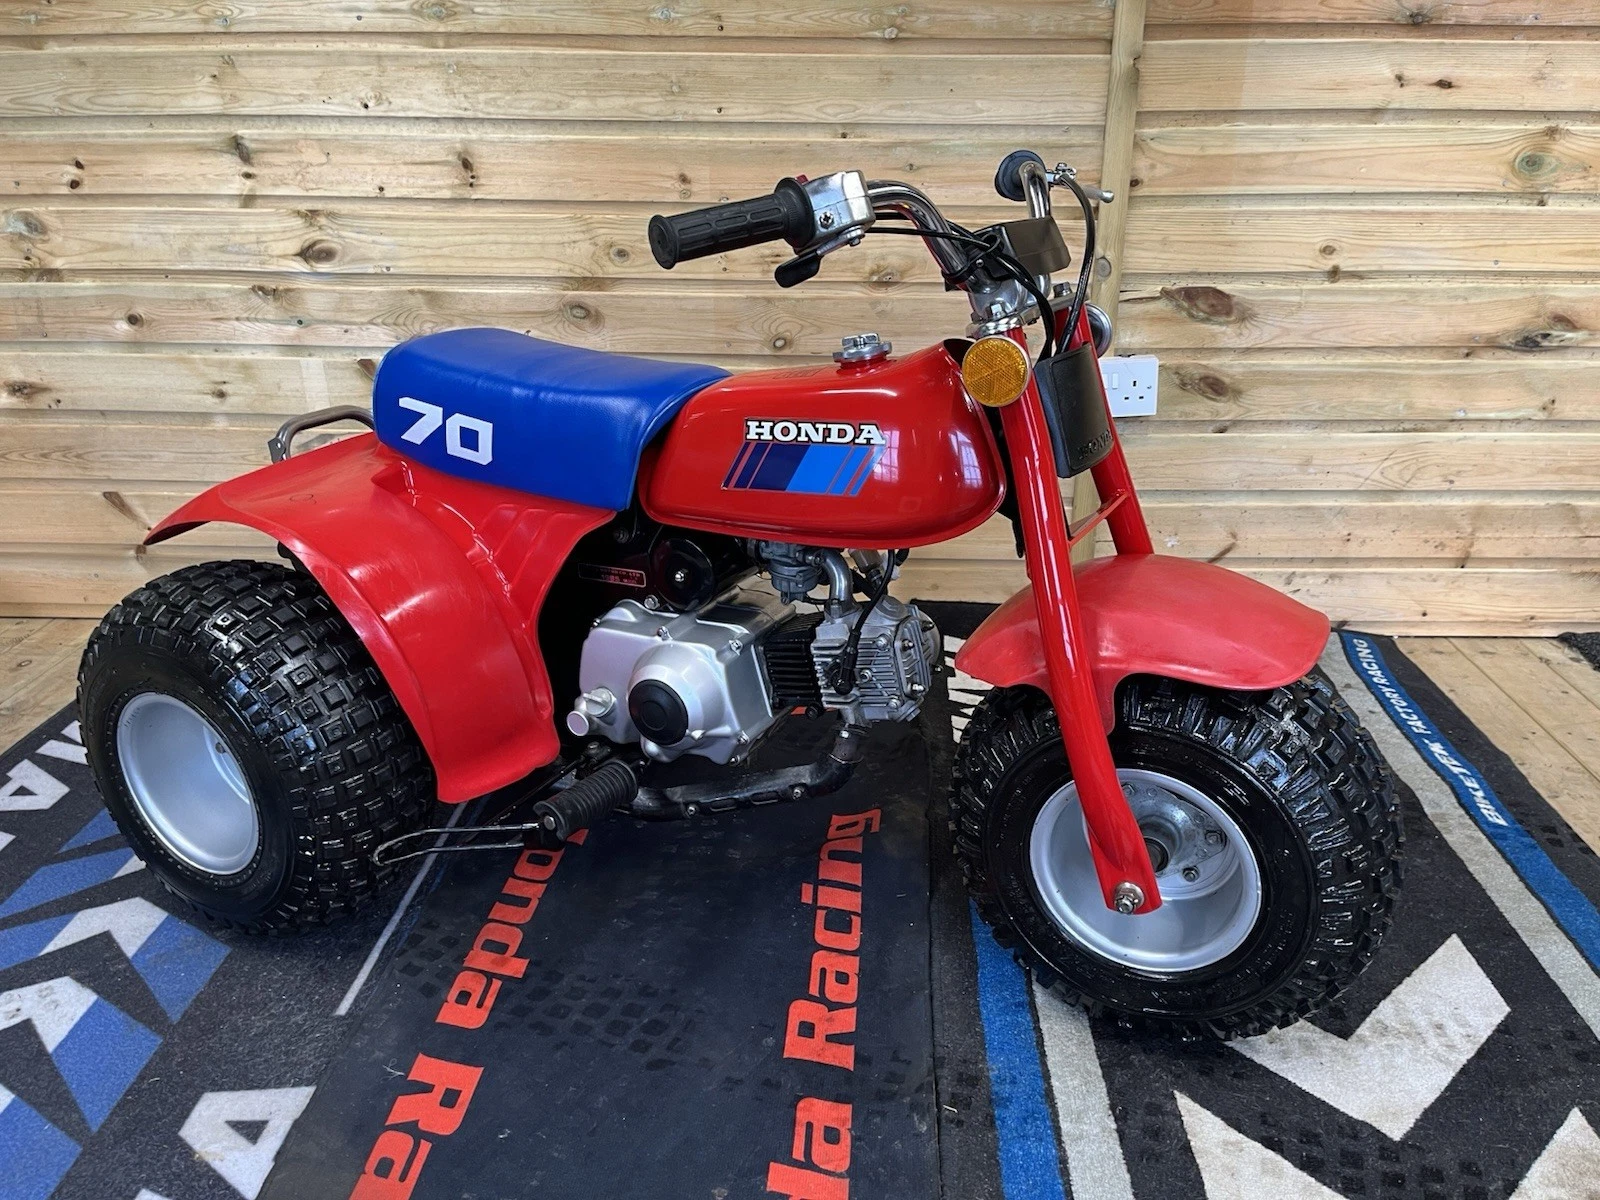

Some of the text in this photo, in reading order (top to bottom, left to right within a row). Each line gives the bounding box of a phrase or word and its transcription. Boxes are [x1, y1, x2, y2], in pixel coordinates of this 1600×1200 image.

[399, 397, 493, 466] 70
[746, 420, 886, 445] HONDA
[1352, 638, 1390, 685] RACING
[1378, 684, 1432, 735] FACTORY
[437, 828, 589, 1029] onda
[783, 808, 881, 1071] Racing
